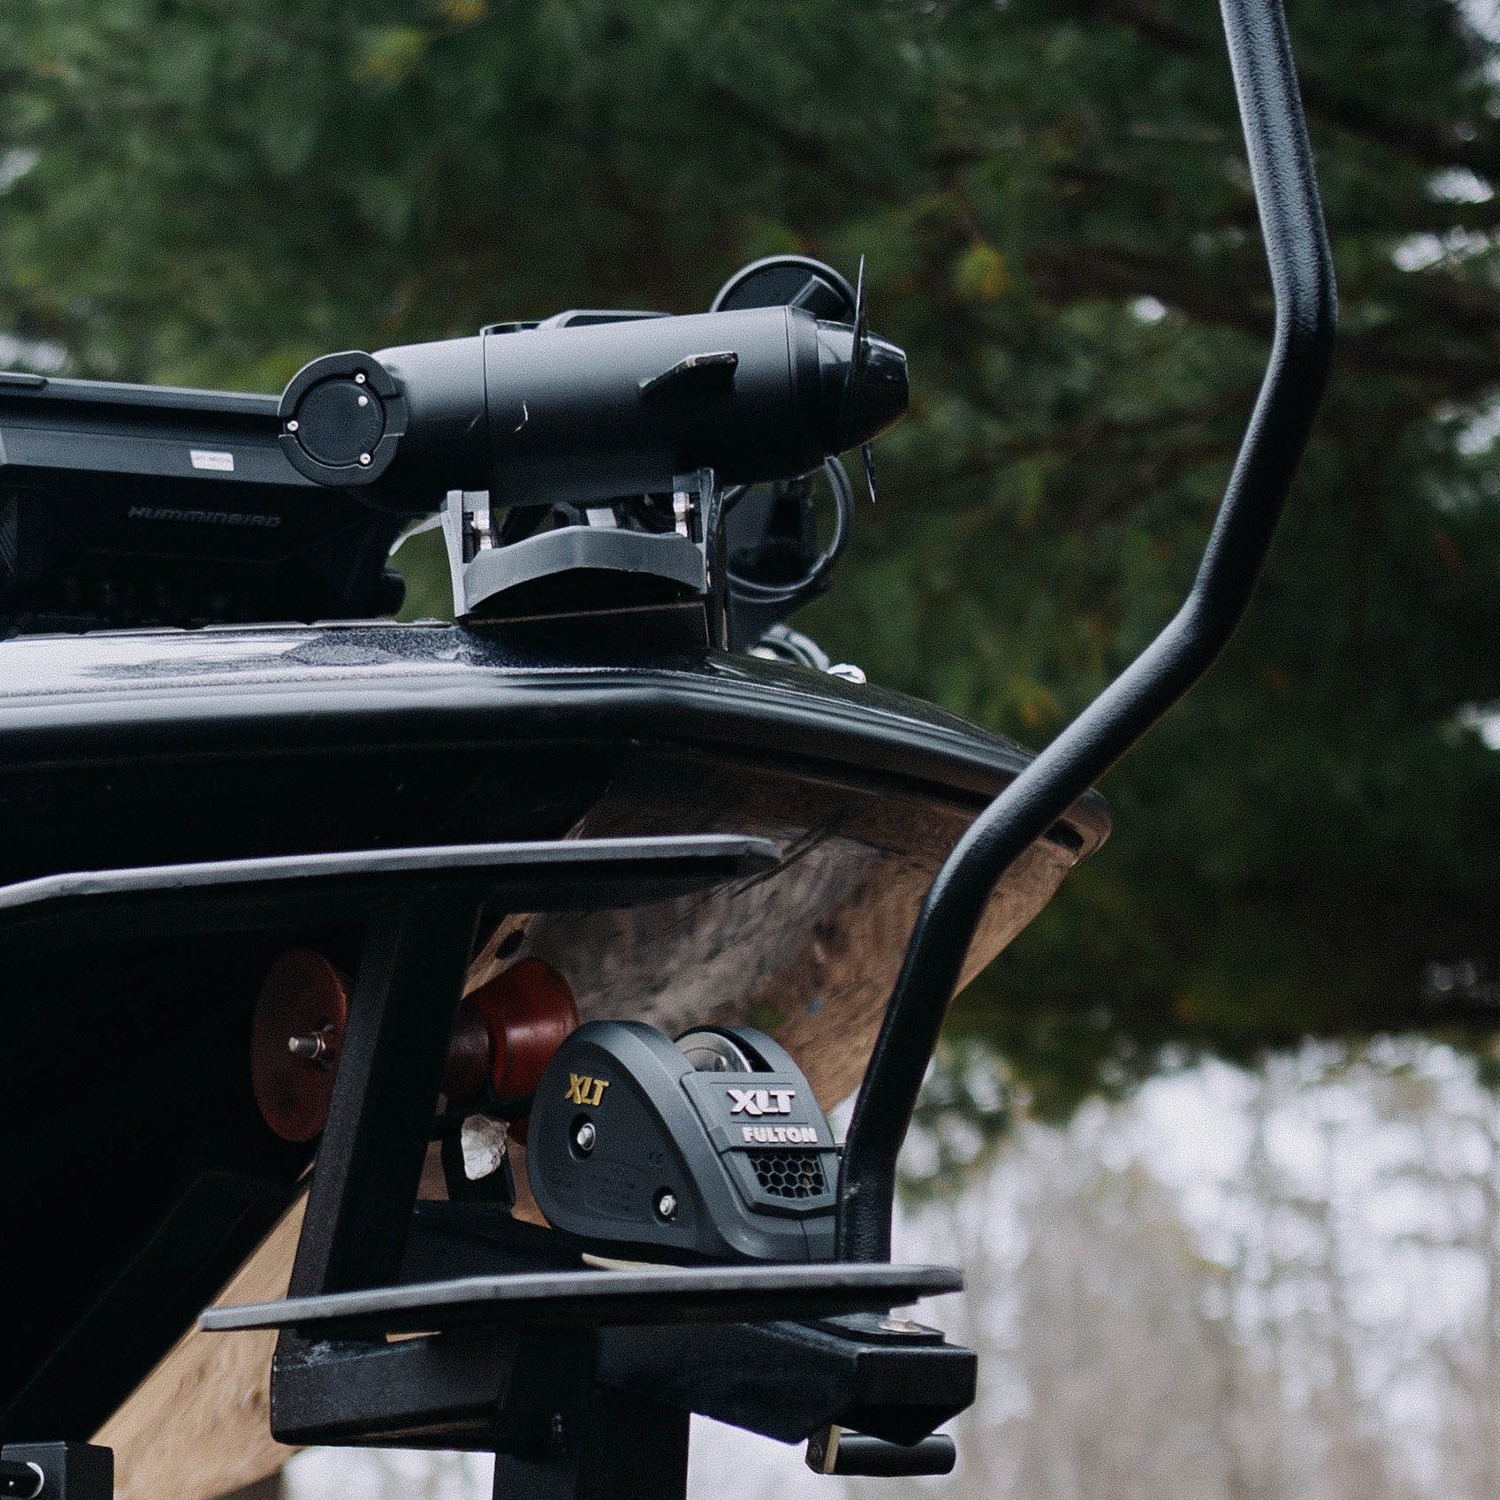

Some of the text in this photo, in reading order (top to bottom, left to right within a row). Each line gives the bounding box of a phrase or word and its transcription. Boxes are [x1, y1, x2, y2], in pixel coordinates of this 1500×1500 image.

[565, 1073, 609, 1106] XLT
[727, 1089, 796, 1115] XLT
[742, 1126, 818, 1143] FULTON
